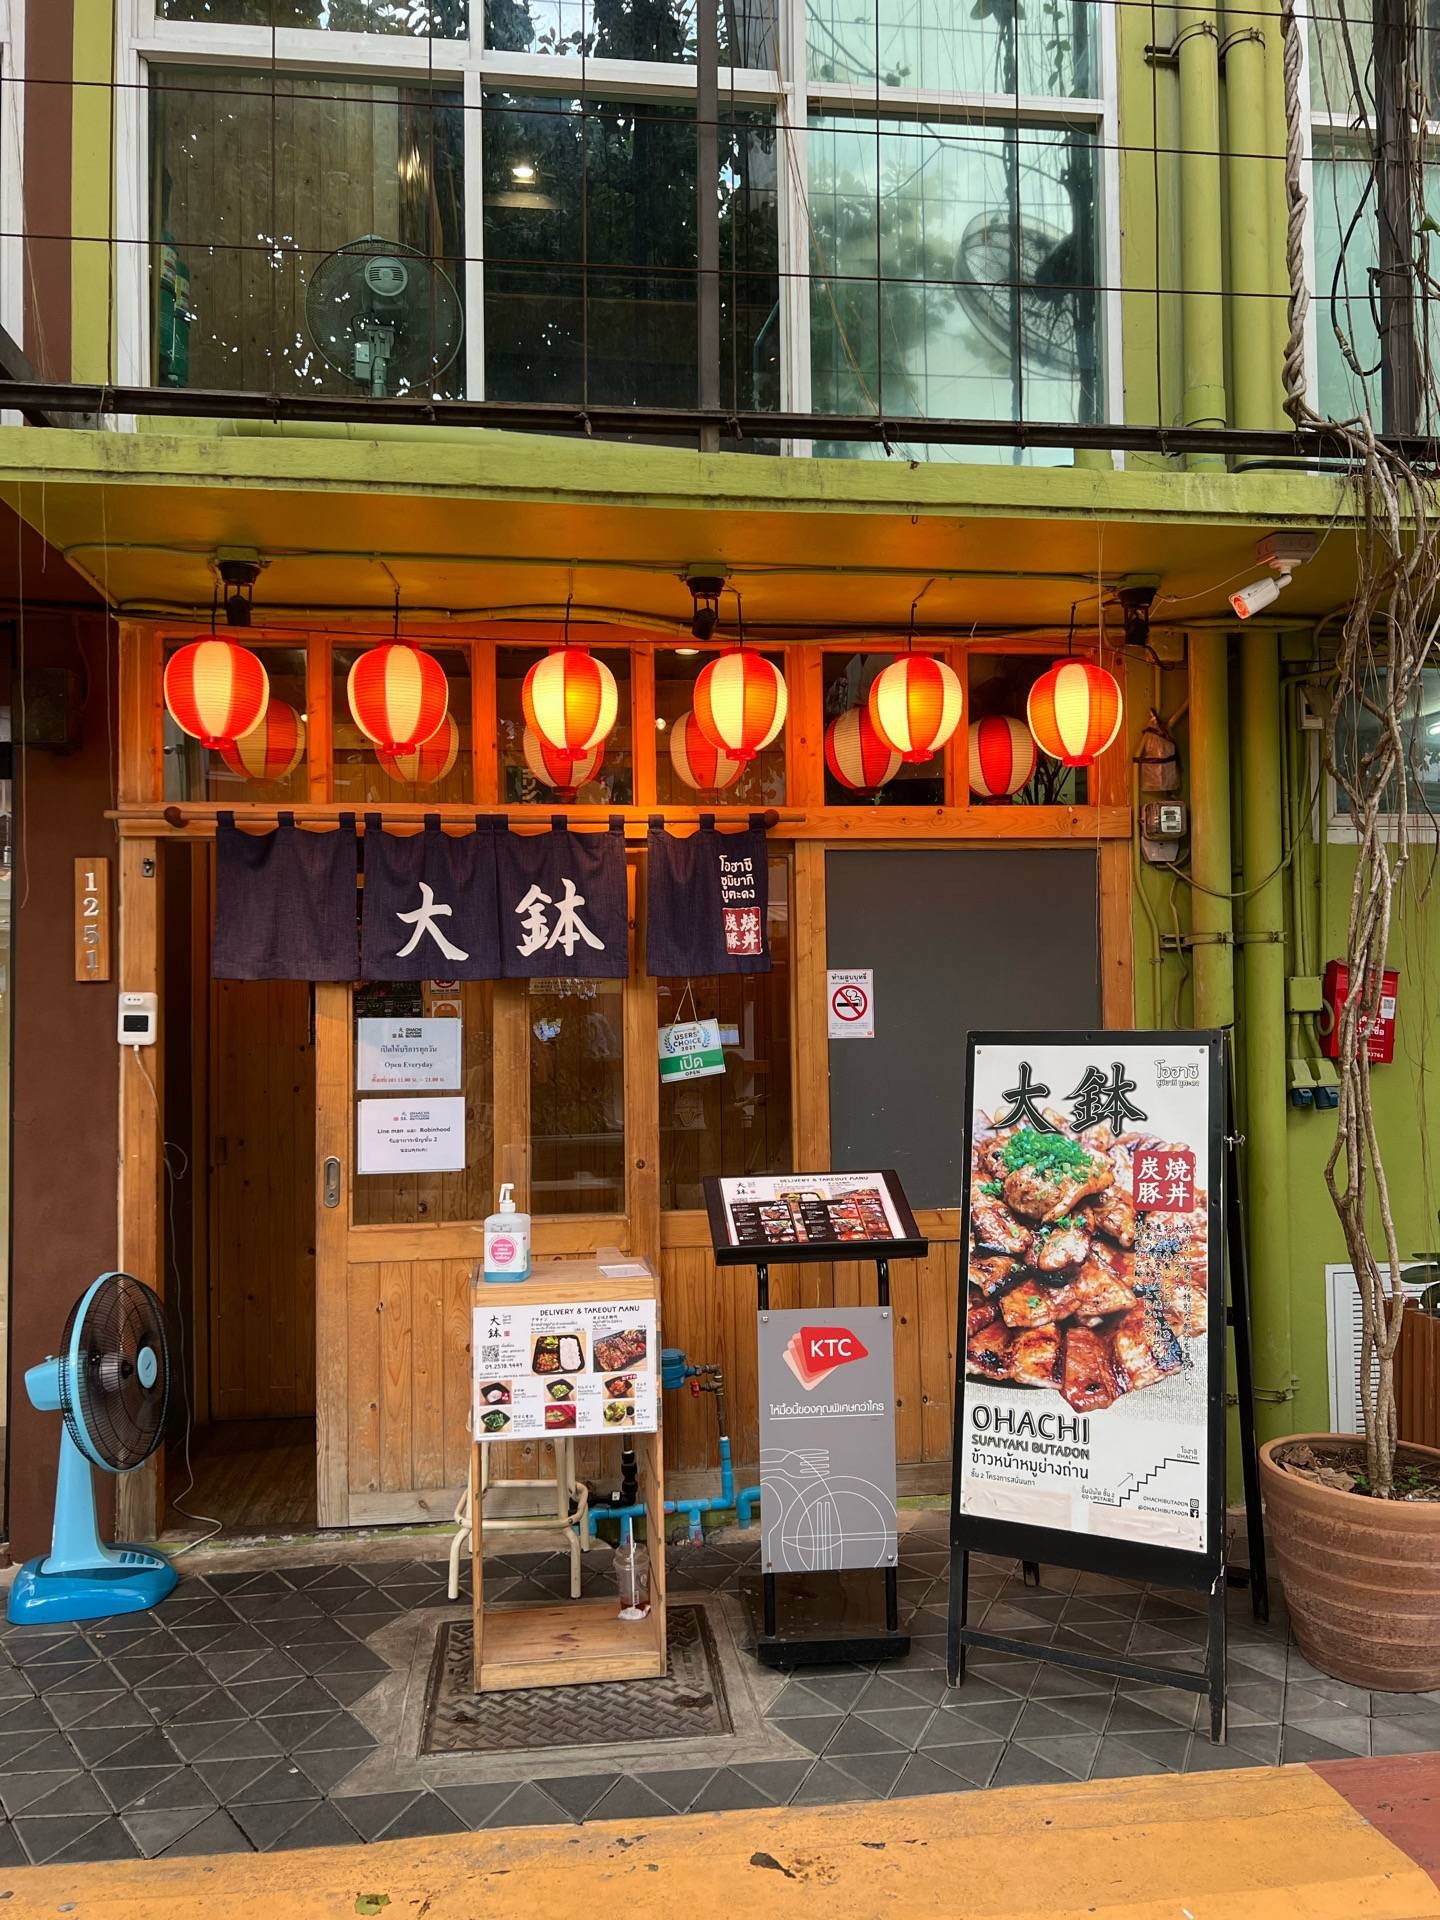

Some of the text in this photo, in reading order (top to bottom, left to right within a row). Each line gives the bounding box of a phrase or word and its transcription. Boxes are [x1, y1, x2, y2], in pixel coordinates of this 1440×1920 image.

[719, 855, 753, 872] โอฮาชิ
[83, 872, 100, 969] 1251
[673, 1037, 702, 1047] CHOICE
[385, 1061, 433, 1069] Open Everyday
[680, 1055, 703, 1070] เปิด
[1136, 1157, 1192, 1184] 炭焼
[1136, 1183, 1191, 1208] 豚丼
[540, 1308, 574, 1316] DELIVERY
[811, 1338, 851, 1357] KTC
[769, 1400, 884, 1416] ให้มื้อนี้ของคุณพิเศษกว่าใคร
[971, 1404, 1090, 1445] OHACHI
[971, 1433, 1090, 1460] SUMIYAKI BUTADON
[972, 1448, 1089, 1479] ข้าวหน้าหมูย่างถ่าน
[1143, 1496, 1188, 1507] OHACHIBUTADON
